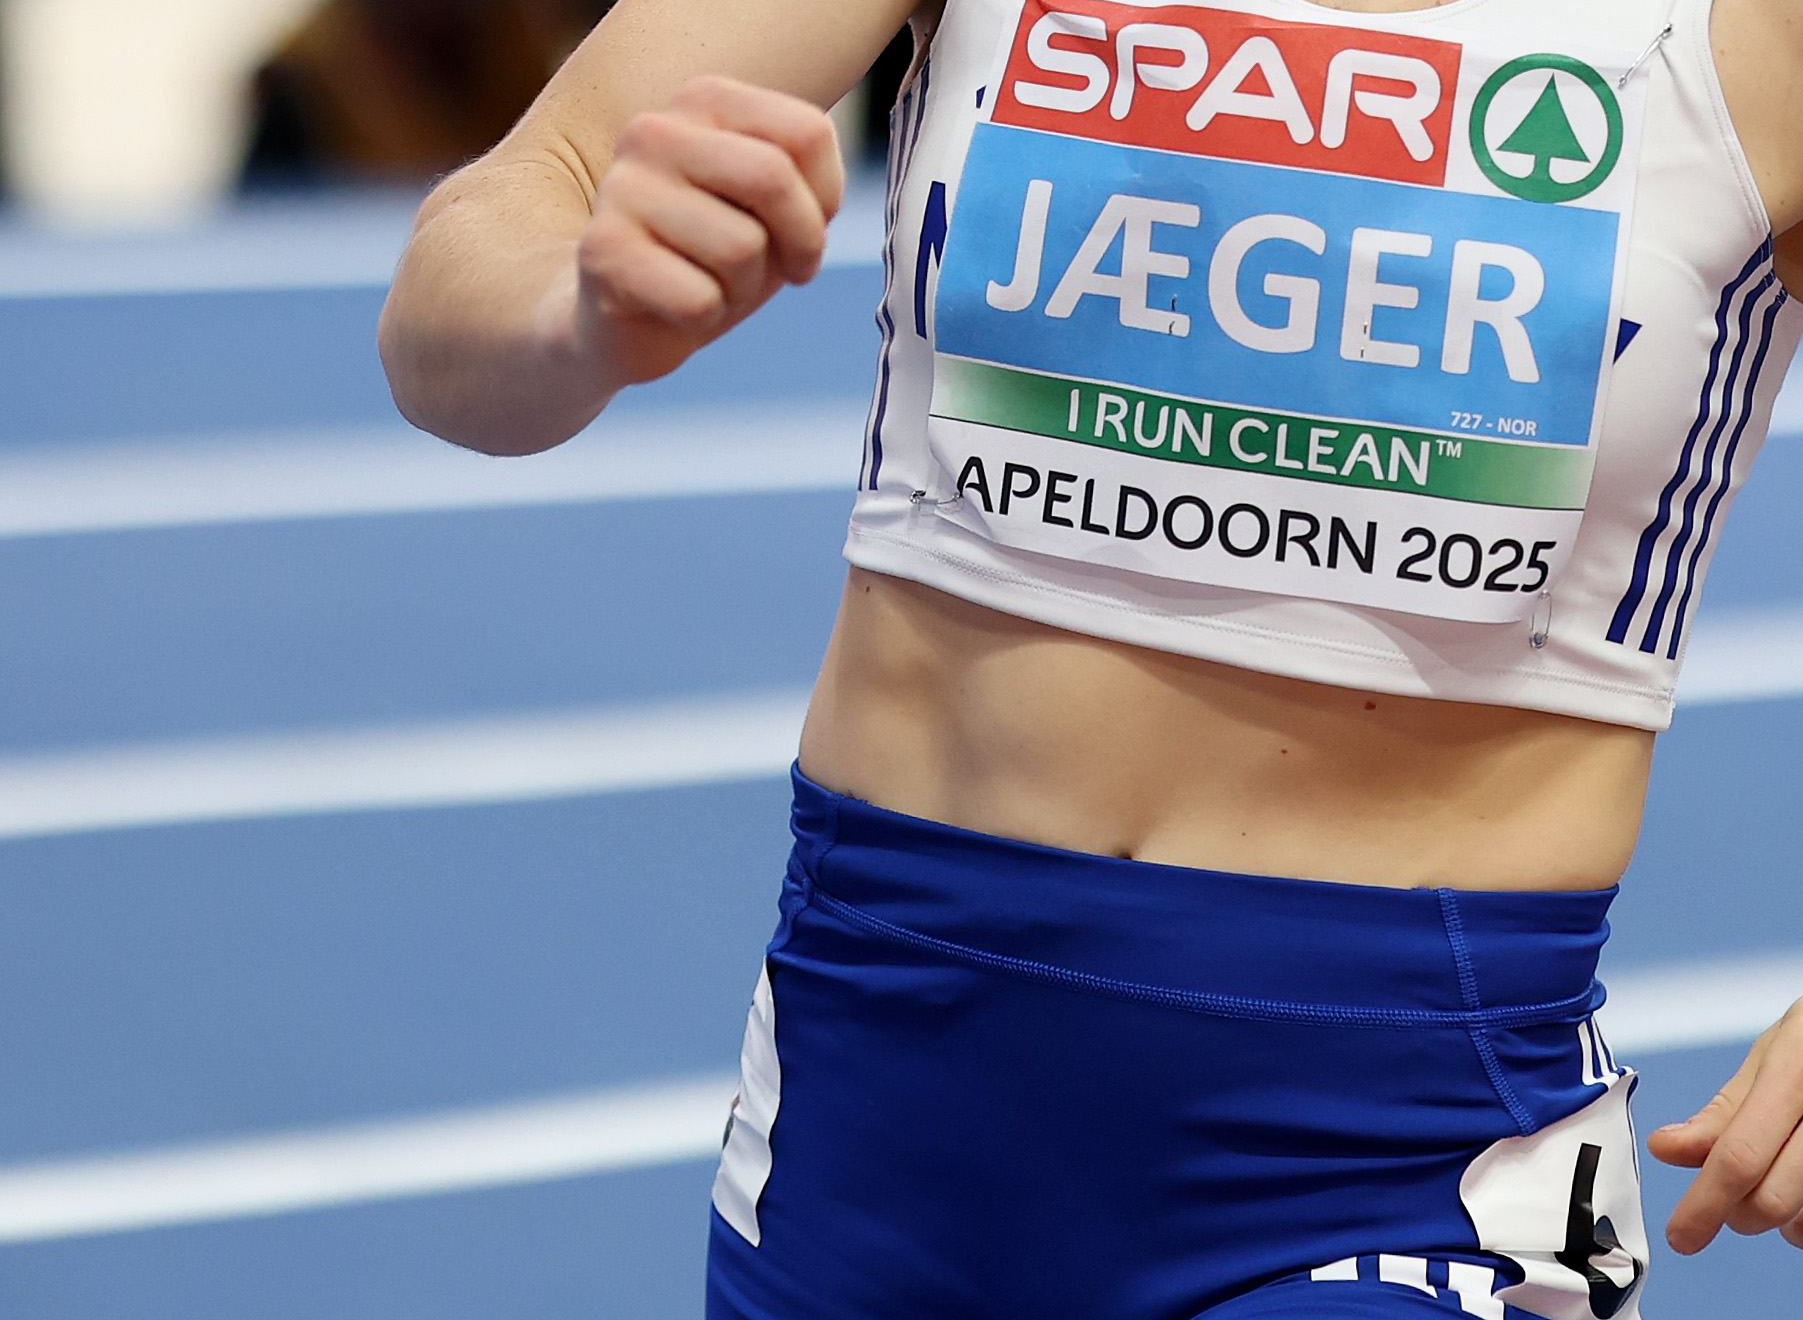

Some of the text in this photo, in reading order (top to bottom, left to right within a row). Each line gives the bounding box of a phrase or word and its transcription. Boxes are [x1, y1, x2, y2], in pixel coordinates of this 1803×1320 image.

[1013, 11, 1443, 163] SPAR
[985, 178, 1547, 385] JÆGER
[1068, 388, 1082, 433] I
[1093, 392, 1217, 457] RUN
[1451, 411, 1483, 430] 727
[1497, 417, 1538, 437] NOR
[956, 456, 1558, 595] APELDOORN 2025
